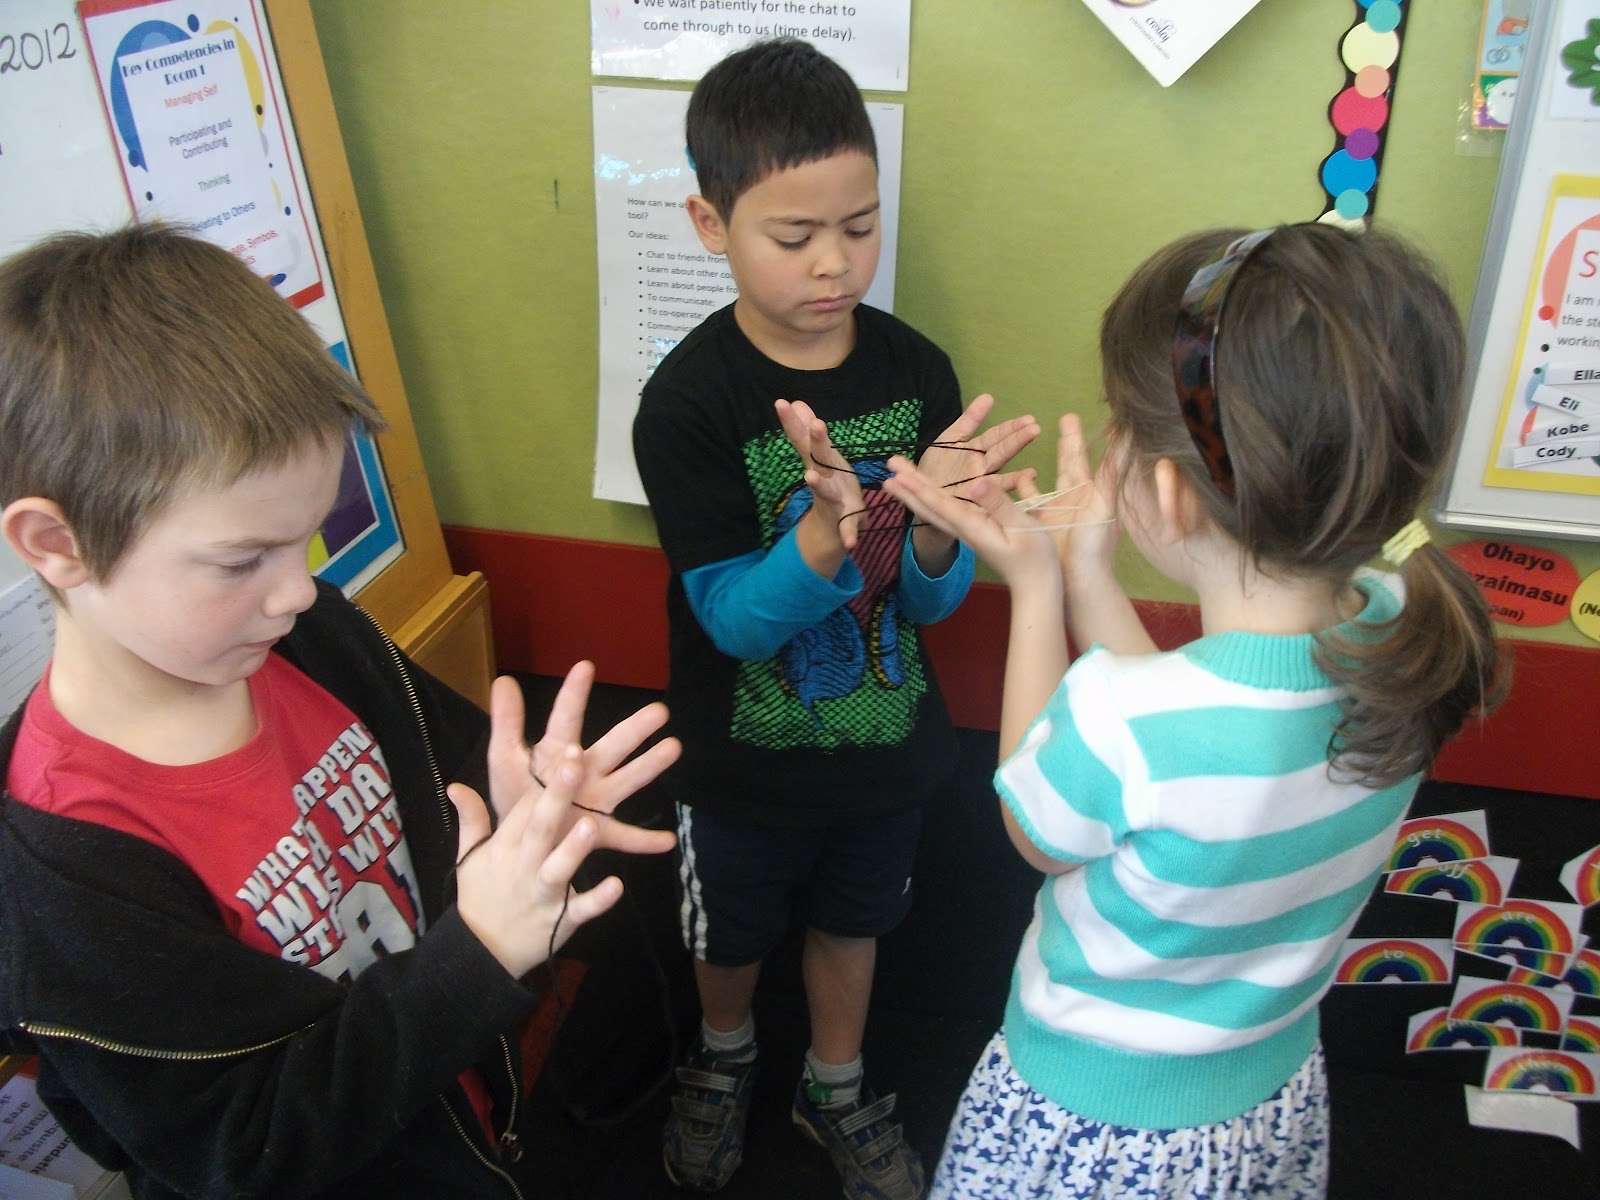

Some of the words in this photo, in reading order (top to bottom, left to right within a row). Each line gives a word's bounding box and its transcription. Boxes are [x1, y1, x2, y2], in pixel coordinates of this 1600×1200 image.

[669, 0, 696, 9] wait
[700, 0, 757, 13] patiently
[761, 0, 779, 12] for
[784, 1, 806, 14] the
[809, 3, 838, 16] chat
[842, 5, 856, 16] to
[643, 21, 679, 31] come
[683, 19, 734, 36] through
[738, 22, 751, 34] to
[755, 25, 770, 35] us
[773, 22, 808, 38] (time
[812, 25, 856, 41] delay).
[0, 23, 76, 73] 2012
[121, 63, 143, 78] Key
[145, 42, 223, 72] Competencies
[223, 38, 235, 51] in
[164, 67, 198, 86] Room
[164, 89, 204, 109] Managing
[168, 123, 218, 147] Participating
[218, 118, 232, 131] and
[182, 136, 229, 159] Contributing
[198, 173, 231, 192] Thinking
[627, 197, 647, 207] How
[648, 199, 663, 208] can
[664, 200, 677, 208] we
[222, 211, 232, 221] to
[231, 201, 256, 217] Others
[627, 212, 649, 221] tool?
[628, 230, 644, 239] Our
[645, 231, 670, 241] ideas:
[646, 250, 666, 260] Chat
[666, 252, 676, 261] to
[677, 253, 705, 263] friends
[707, 254, 728, 264] from
[646, 265, 670, 275] Learn
[671, 266, 695, 277] about
[696, 268, 719, 279] other
[646, 279, 670, 289] Learn
[670, 280, 695, 291] about
[696, 282, 724, 294] people
[726, 284, 739, 295] fro
[647, 293, 657, 303] To
[1573, 296, 1594, 307] am
[647, 307, 657, 316] To
[647, 321, 694, 333] Communica
[1561, 314, 1583, 327] the
[1557, 335, 1600, 347] workin
[1558, 395, 1580, 411] Eli
[1547, 420, 1590, 438] Kobe
[1536, 445, 1577, 459] Cody
[1483, 542, 1555, 572] Ohayo
[1474, 573, 1568, 607] zaimasu
[292, 722, 375, 816] APPEN
[1407, 827, 1443, 848] get
[1501, 910, 1538, 924] are
[1382, 947, 1405, 960] to
